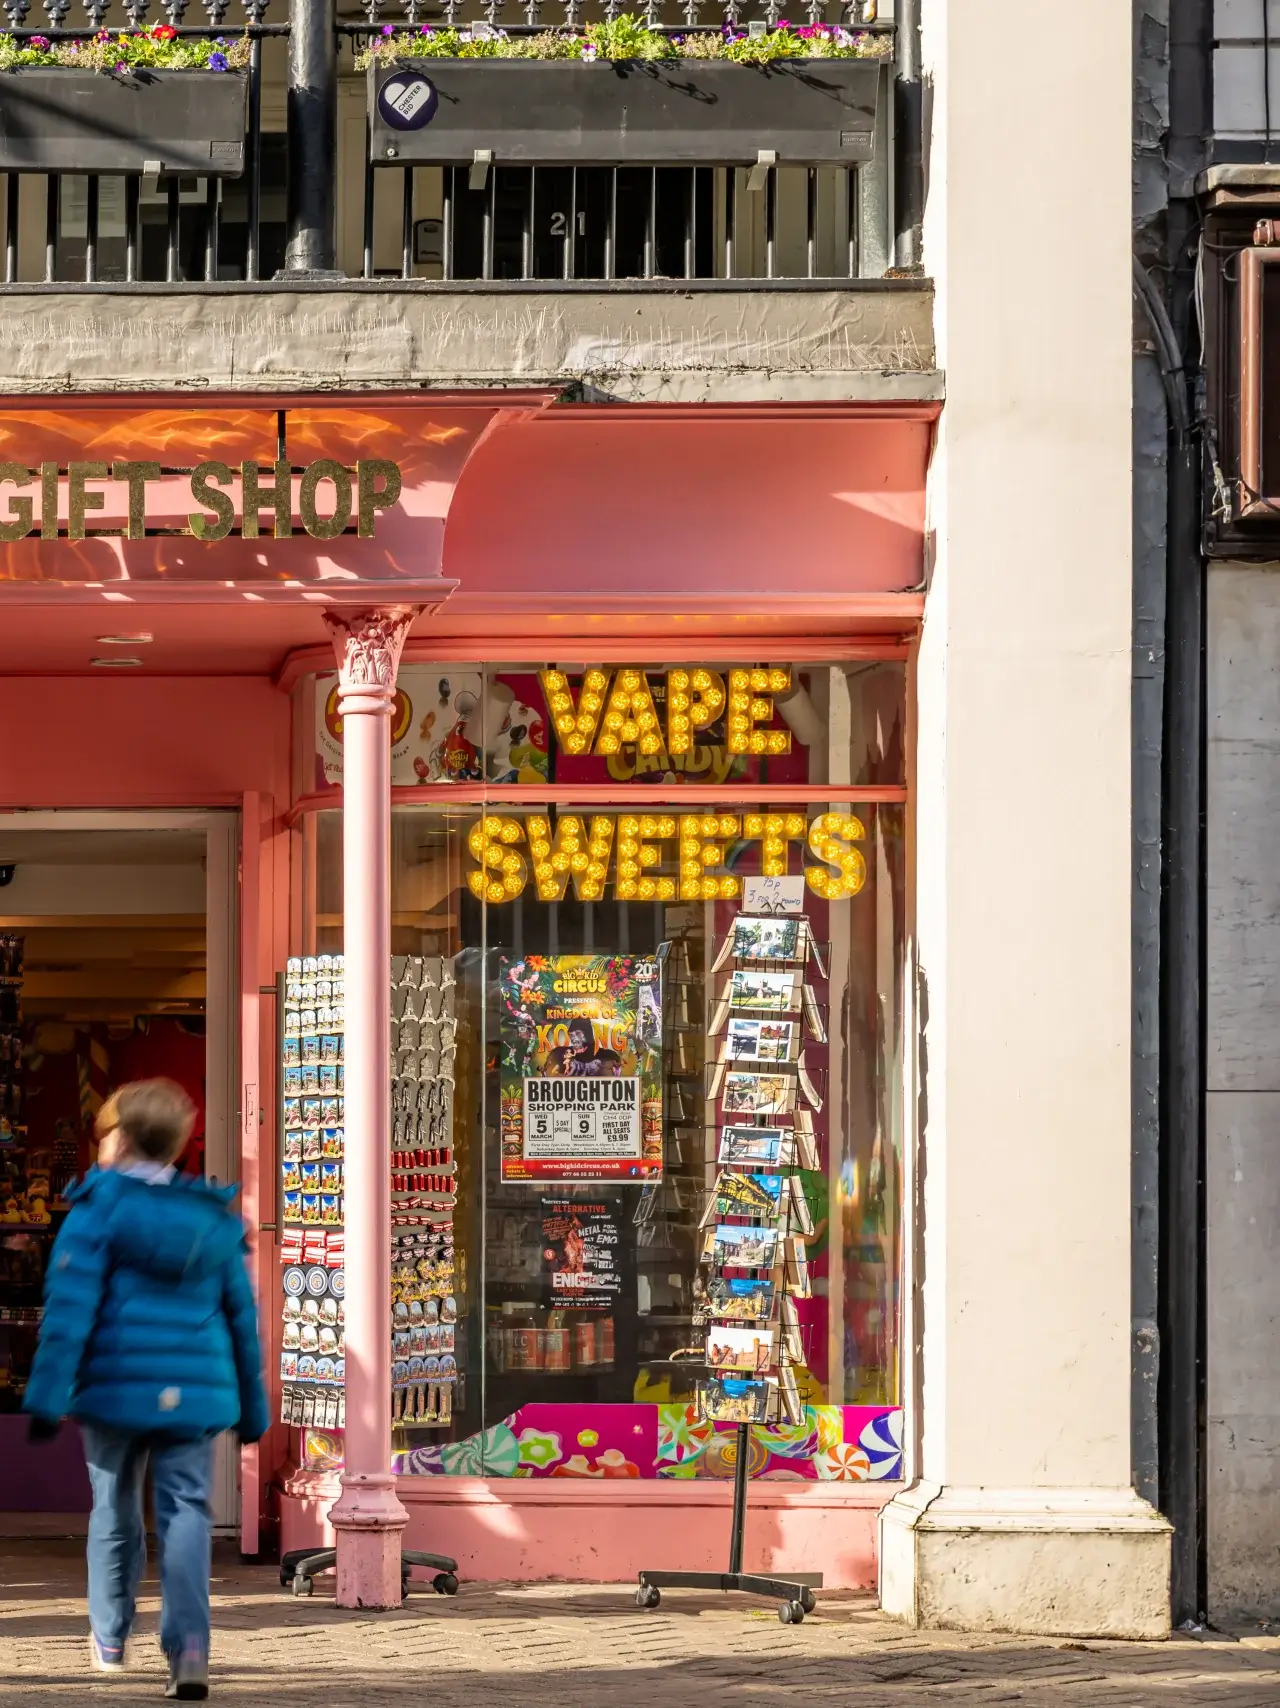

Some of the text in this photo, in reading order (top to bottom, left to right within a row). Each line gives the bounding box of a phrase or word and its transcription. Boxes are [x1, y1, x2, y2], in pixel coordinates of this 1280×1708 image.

[398, 85, 422, 111] CHESTER
[402, 103, 414, 115] BID
[550, 211, 586, 236] 21
[187, 458, 402, 542] SHOP
[537, 667, 793, 756] VAPE
[465, 813, 867, 903] SWEETS
[748, 890, 756, 903] 3
[553, 979, 607, 993] CIRCUS
[546, 1009, 617, 1020] KINGDOM OF
[527, 1080, 636, 1102] BROUGHTON
[528, 1103, 636, 1111] SHOPPING PARK
[536, 1120, 548, 1134] 5
[579, 1120, 590, 1134] 9
[602, 1121, 619, 1129] FIRST
[613, 1127, 631, 1135] SEATS
[542, 1162, 621, 1170] www.bigkidcircus.co.uk
[552, 1204, 606, 1213] ALTERNATIVE
[578, 1224, 601, 1238] METAL
[596, 1234, 618, 1245] EMO
